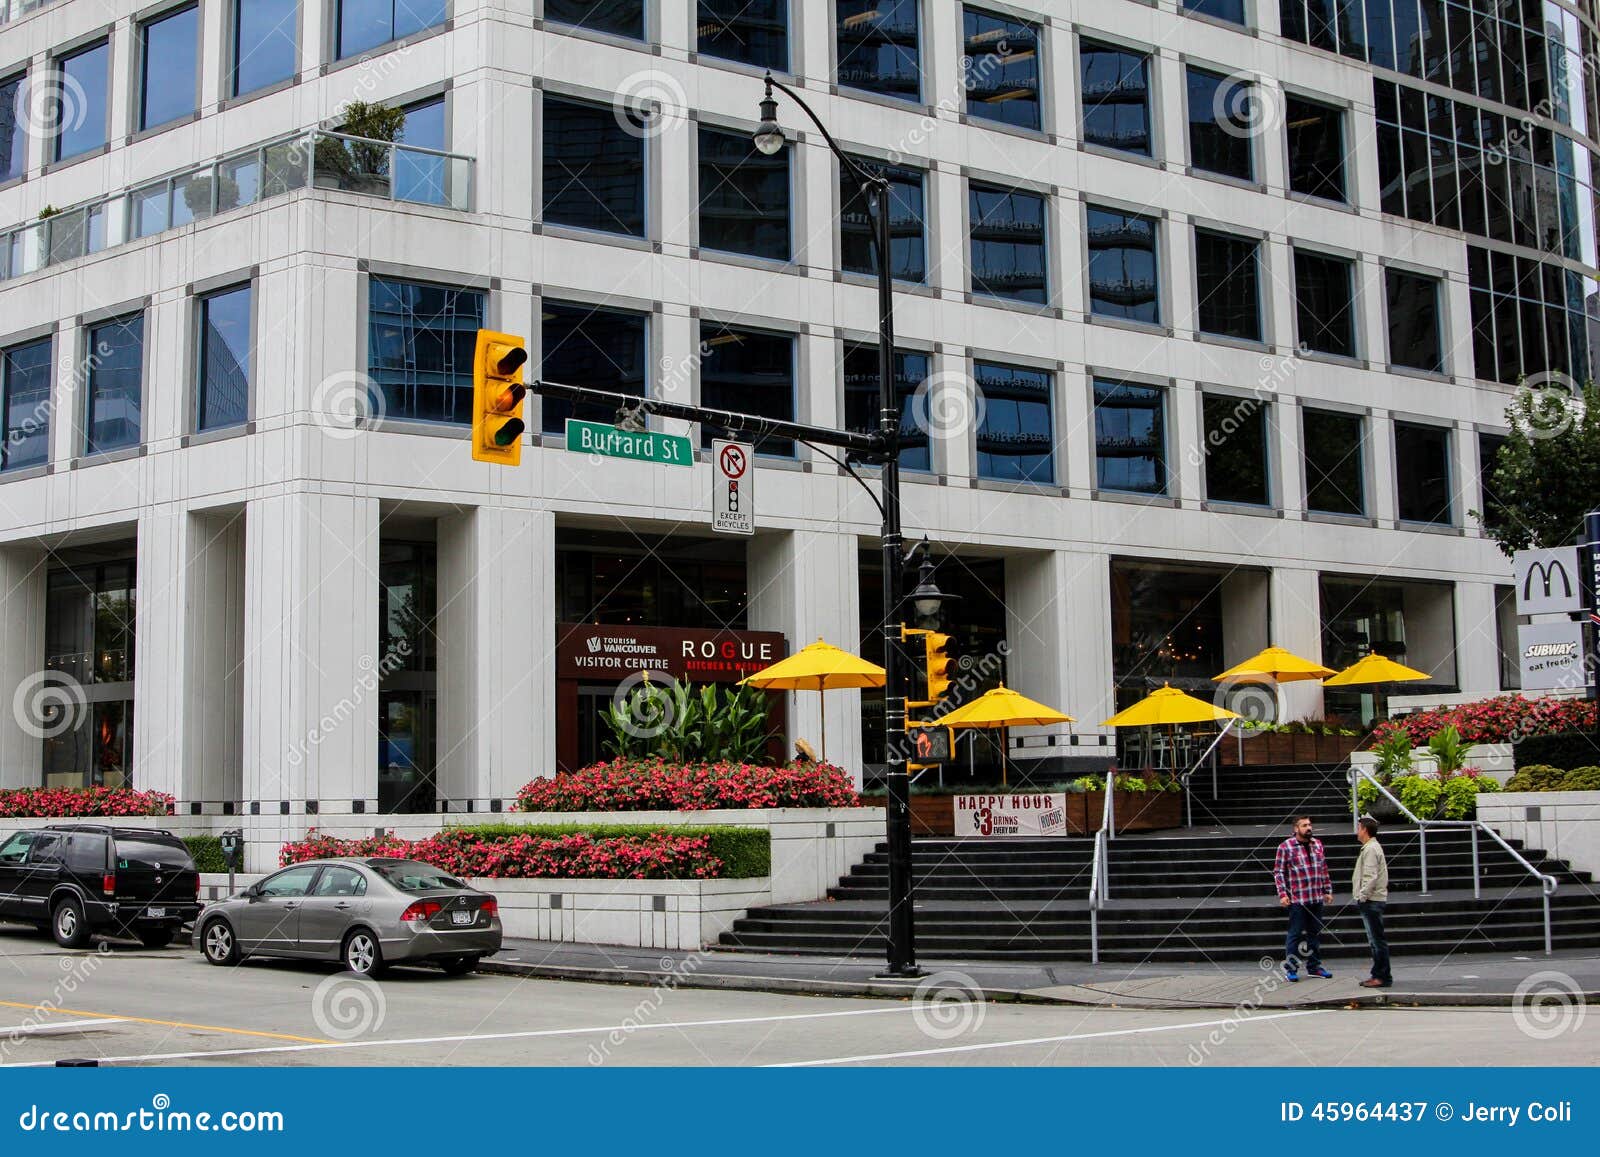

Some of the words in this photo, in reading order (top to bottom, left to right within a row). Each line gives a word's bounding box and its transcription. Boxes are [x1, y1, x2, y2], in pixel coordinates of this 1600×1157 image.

[581, 427, 654, 457] Burrard
[662, 439, 680, 460] St
[720, 512, 746, 521] EXCEPT
[717, 520, 750, 530] BICYCLES
[604, 637, 636, 645] TOURISM
[604, 644, 657, 654] VANCOUVER
[682, 640, 772, 660] ROGUE
[1525, 643, 1576, 658] SUBWAY
[575, 656, 621, 668] VISITOR
[625, 658, 669, 669] CENTRE
[1529, 663, 1544, 671] eat
[959, 795, 1005, 810] HAPPY
[1012, 795, 1053, 809] HOUR
[993, 815, 1018, 825] DRINKS
[993, 826, 1008, 834] EVERY
[1009, 826, 1018, 834] DAY
